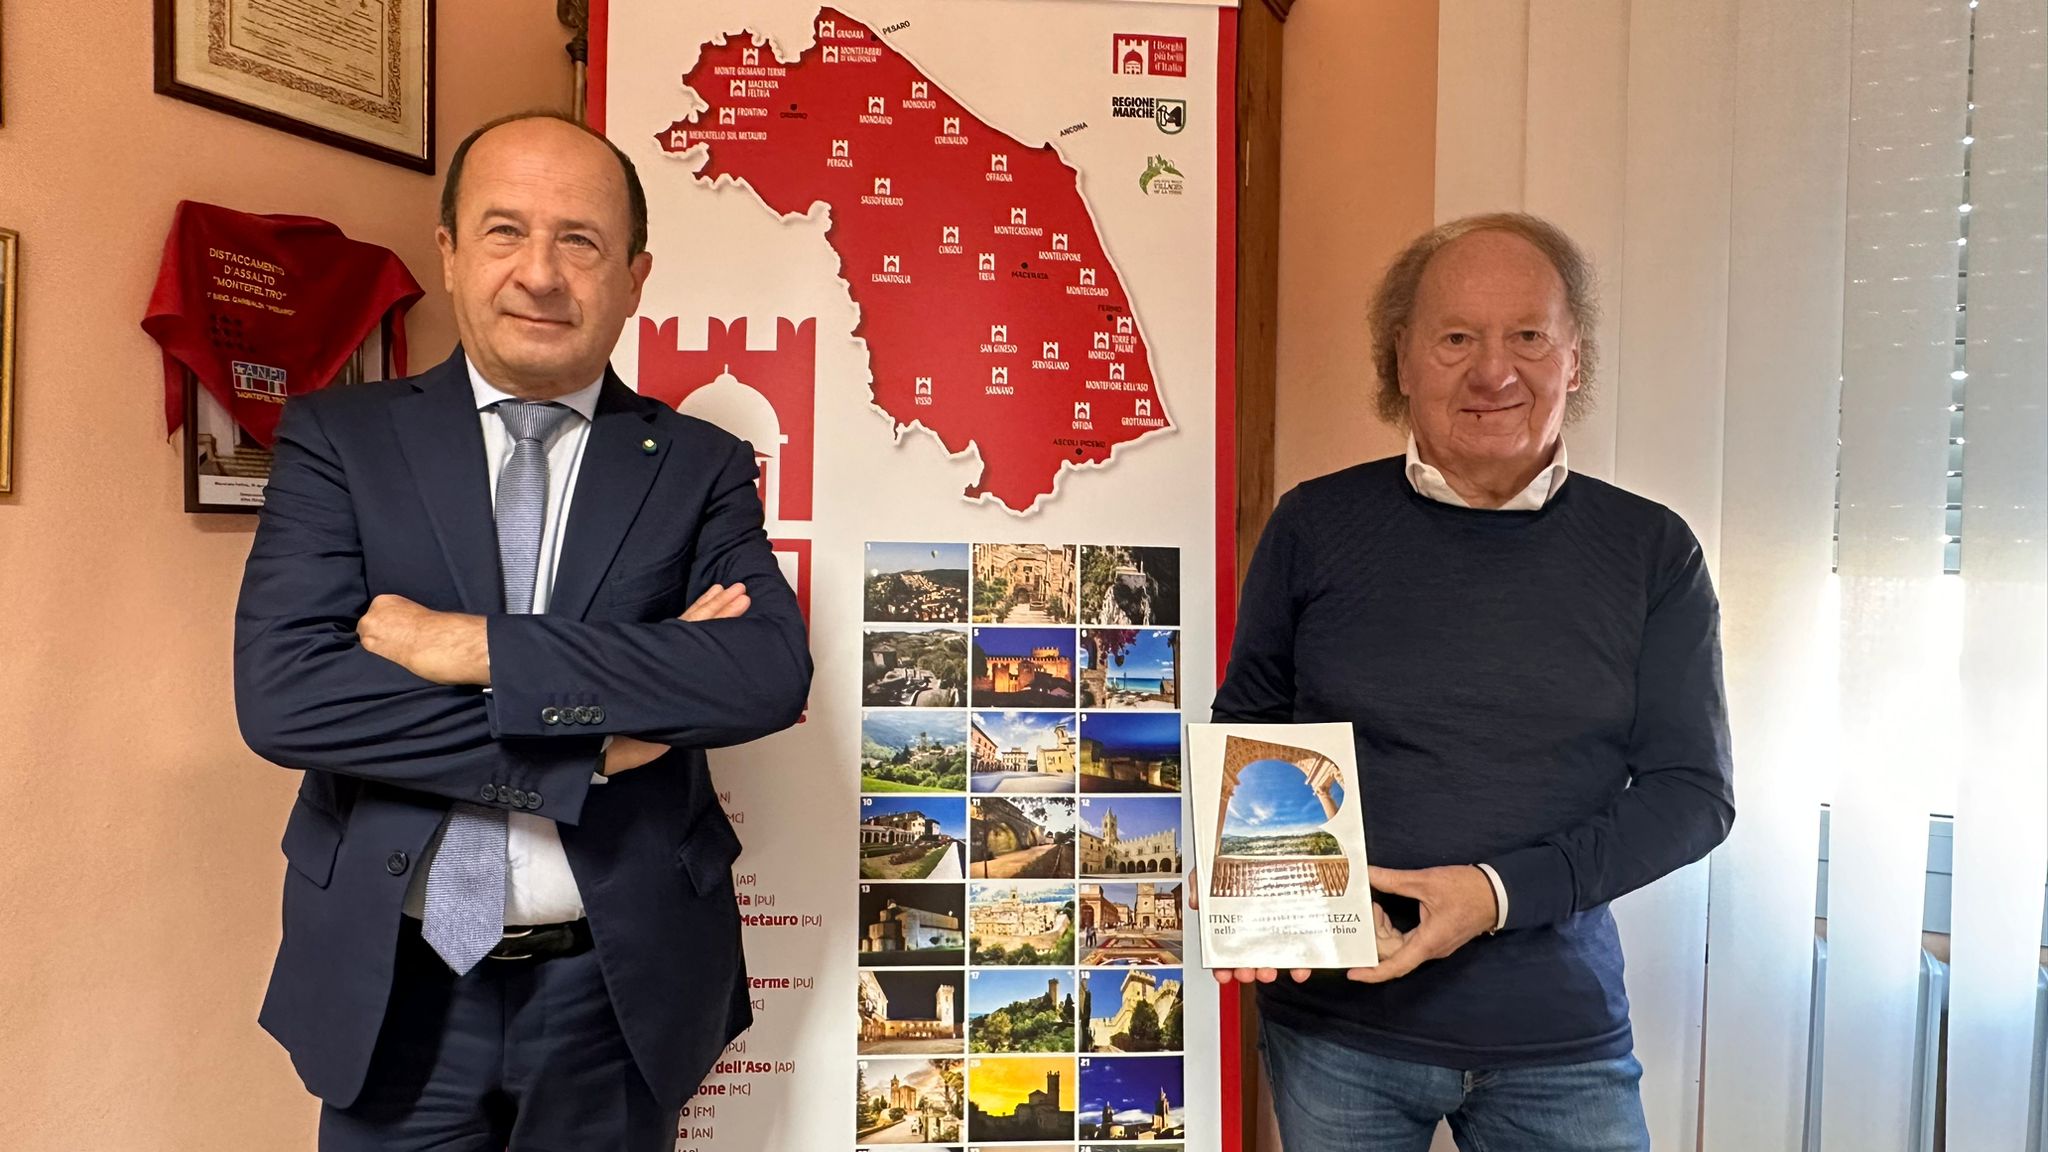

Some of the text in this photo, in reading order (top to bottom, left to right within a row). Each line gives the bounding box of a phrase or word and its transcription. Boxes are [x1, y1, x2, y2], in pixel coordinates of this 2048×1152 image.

[882, 20, 911, 35] PESARO
[836, 30, 864, 39] GRADARA
[840, 46, 882, 56] MONTEFABBRI
[1157, 41, 1184, 53] Borghi
[1153, 51, 1184, 63] più belli
[714, 66, 787, 77] MONTE GRIMANO TERME
[1155, 62, 1182, 73] d'Italia
[747, 80, 779, 89] MACERATA
[747, 89, 770, 98] FELTRIA
[902, 99, 937, 109] MONDOLFO
[1112, 97, 1155, 108] REGIONE
[737, 107, 768, 117] FRONTINO
[1112, 107, 1155, 119] MARCHE
[859, 114, 893, 125] MONDAVIO
[1059, 121, 1088, 137] ANCONA
[689, 130, 767, 141] MERCATELLO SUL METAURO
[934, 135, 969, 145] CORINALDO
[827, 158, 853, 168] PERGOLA
[985, 173, 1013, 183] OFFAGNA
[861, 195, 904, 206] SASSOFERRATO
[993, 226, 1043, 237] MONTECASSIANO
[938, 245, 963, 254] CINGOLI
[209, 247, 285, 275] DISTACCAMENTO
[1038, 251, 1081, 262] MONTELUPONE
[224, 264, 275, 286] D'ASSALTO
[871, 273, 911, 284] ESANATOGLIA
[978, 272, 995, 281] TREIA
[212, 275, 287, 300] "MONTEFELTRO"
[1066, 286, 1109, 297] MONTECOSARO
[1112, 335, 1137, 345] TORRE DI
[980, 344, 1018, 354] SAN GINESIO
[1114, 344, 1134, 354] PALME
[1088, 350, 1115, 361] MORESCO
[1031, 360, 1070, 371] SERVIGLIANO
[985, 386, 1014, 396] SARNANO
[1085, 380, 1149, 393] MONTEFIORE DELL'ASO
[915, 396, 932, 406] VISSO
[1072, 421, 1093, 431] OFFIDA
[1121, 417, 1164, 428] GROTTAMMARE
[863, 798, 872, 806] 10
[972, 798, 981, 806] 11
[1081, 798, 1090, 807] 12
[736, 873, 756, 886] (AP)
[861, 885, 870, 893] 13
[754, 894, 775, 906] (PU)
[741, 913, 822, 927] Metauro (PU)
[971, 971, 980, 979] 17
[1080, 971, 1090, 979] 18
[747, 976, 814, 989] Terme (PU)
[715, 1061, 796, 1074] dell'Aso (AP)
[1080, 1059, 1090, 1067] 21
[729, 1083, 751, 1096] (MC)
[693, 1105, 715, 1118] (FM)
[692, 1127, 713, 1139] (AN)
